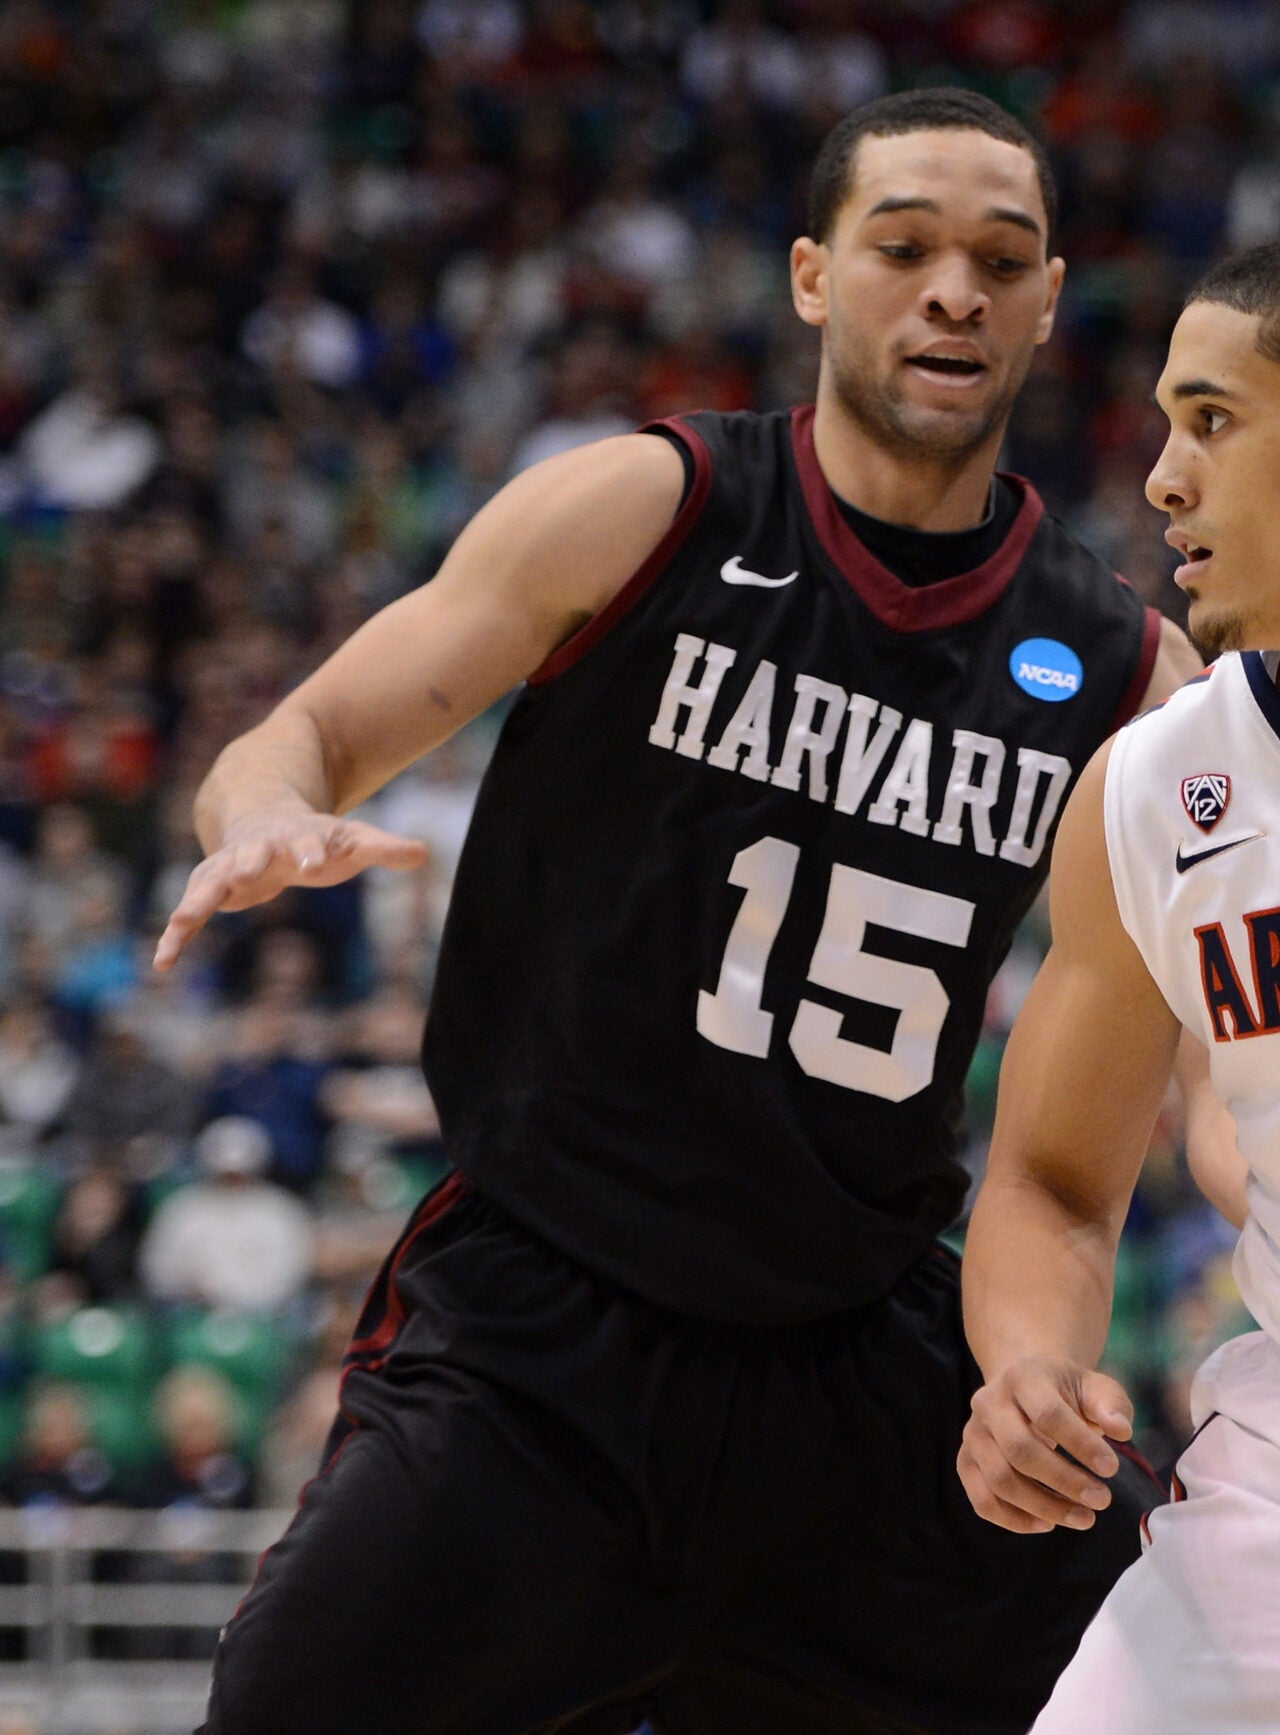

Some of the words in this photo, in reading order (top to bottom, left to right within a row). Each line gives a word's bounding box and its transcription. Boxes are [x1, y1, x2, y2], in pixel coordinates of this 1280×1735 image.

[1018, 662, 1078, 692] NCAA
[649, 633, 1072, 867] HARVARD
[1183, 774, 1228, 811] PAC
[1194, 798, 1217, 822] 12
[696, 836, 976, 1102] 15
